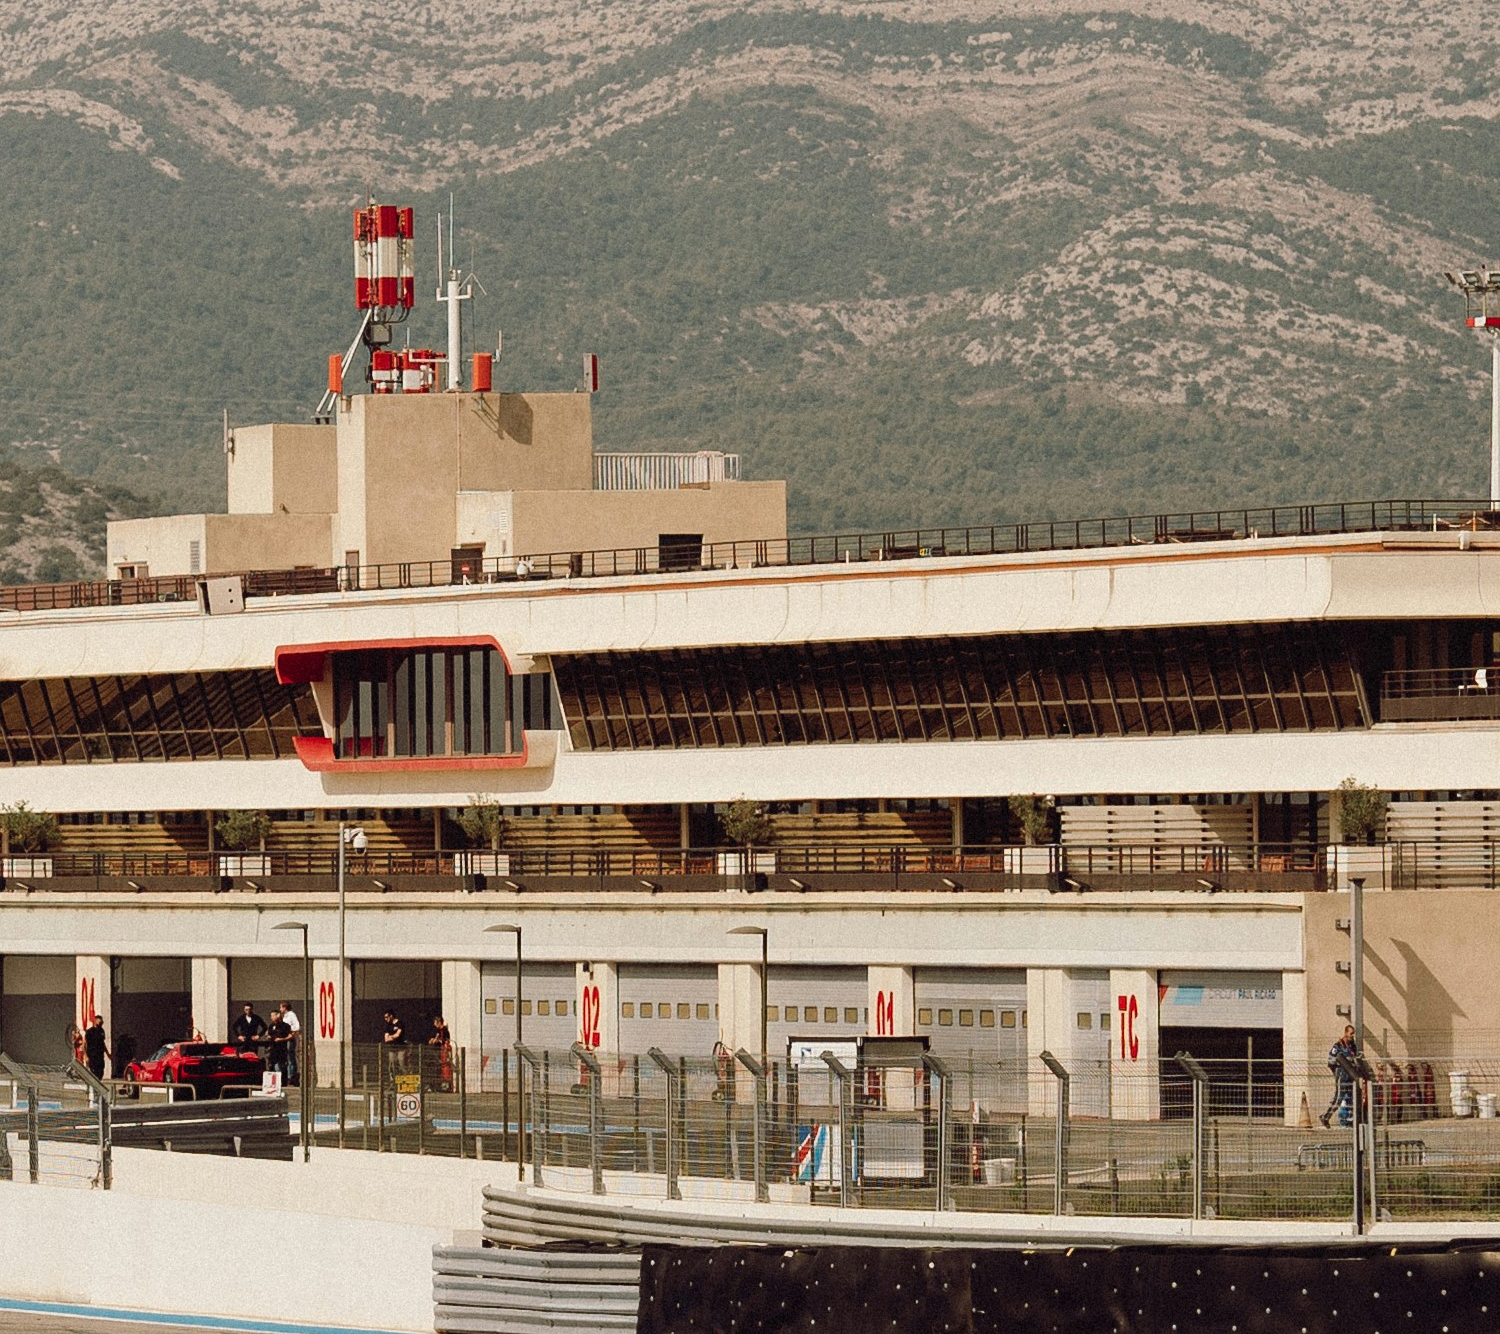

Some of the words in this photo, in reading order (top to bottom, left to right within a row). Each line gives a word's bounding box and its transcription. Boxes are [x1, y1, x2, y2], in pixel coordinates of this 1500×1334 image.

[81, 977, 96, 1031] 04
[319, 981, 336, 1039] 03
[582, 985, 601, 1052] 02
[876, 990, 894, 1035] 01
[1117, 994, 1139, 1062] TC
[400, 1100, 417, 1111] 60
